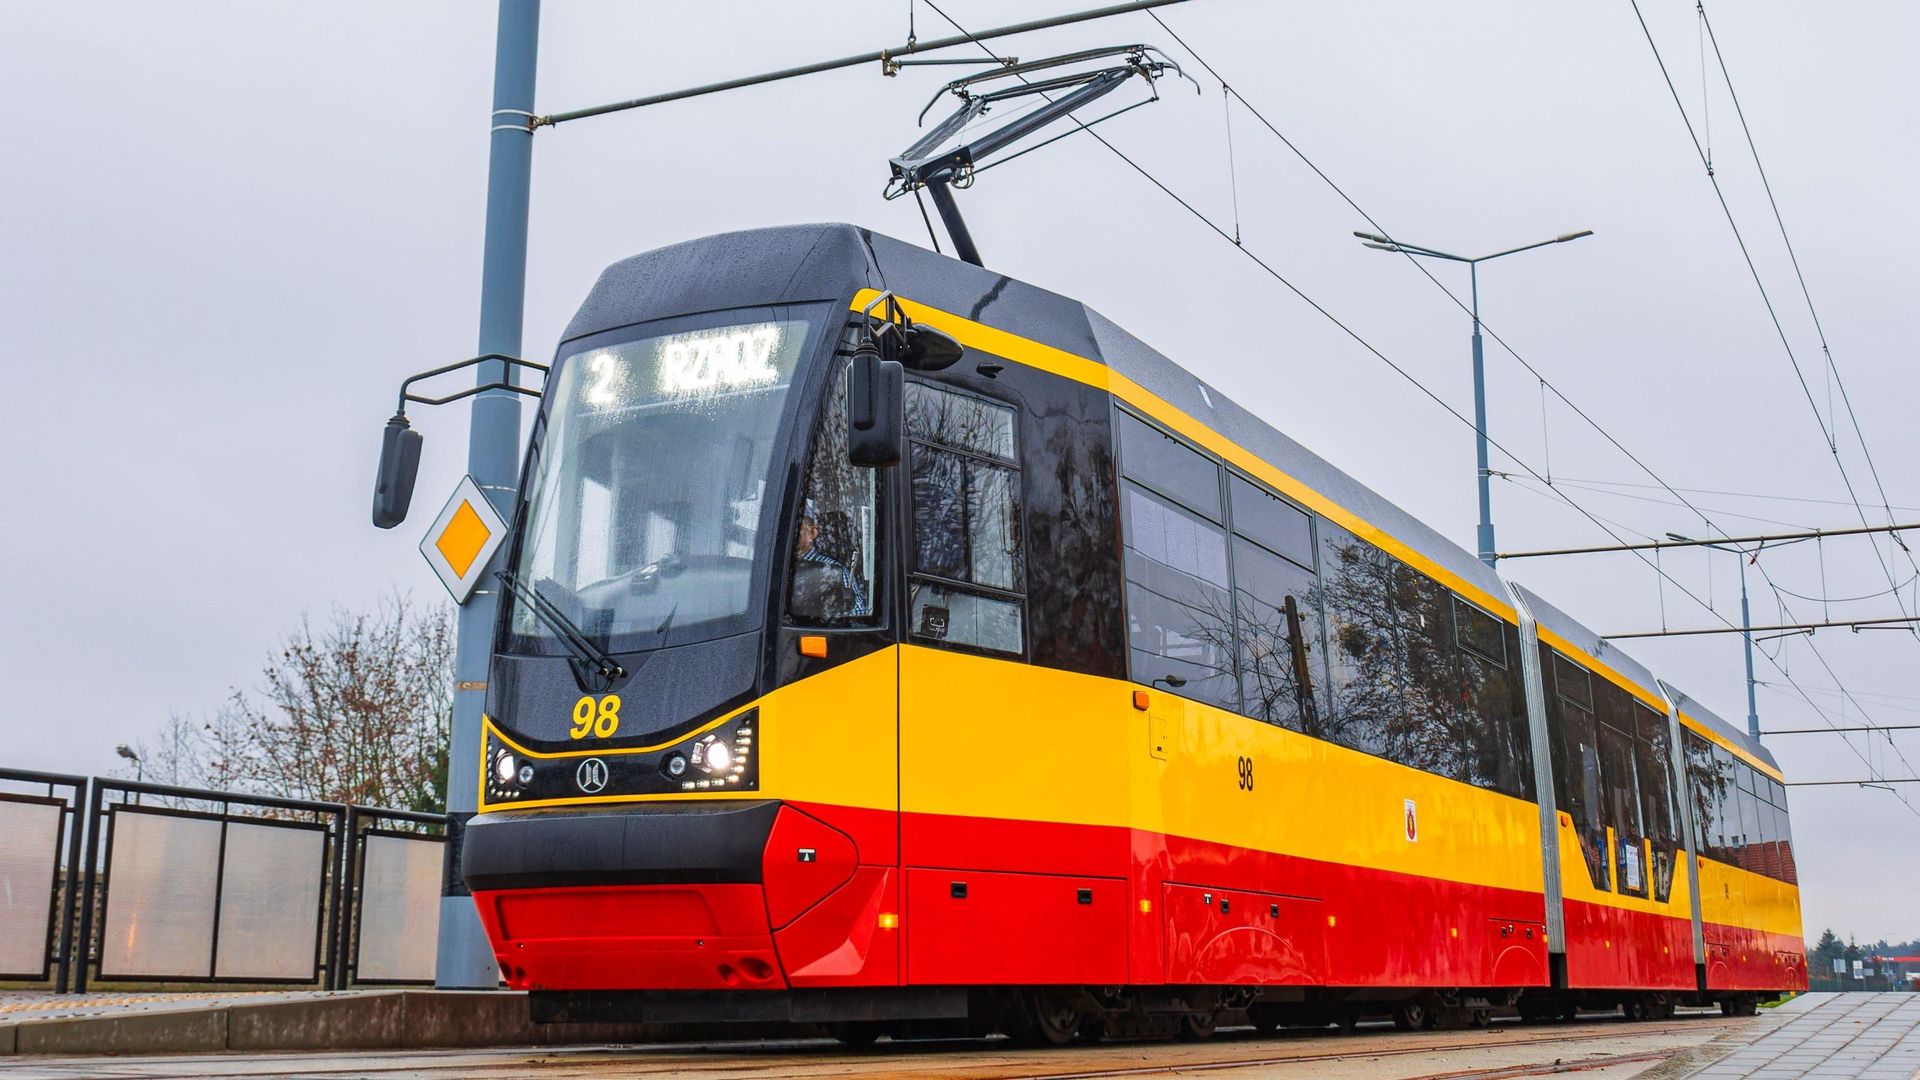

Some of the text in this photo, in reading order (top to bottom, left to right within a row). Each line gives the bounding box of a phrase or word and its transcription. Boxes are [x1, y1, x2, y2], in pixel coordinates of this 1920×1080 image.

[589, 352, 615, 403] 2
[570, 694, 621, 740] 98
[1238, 755, 1254, 792] 98
